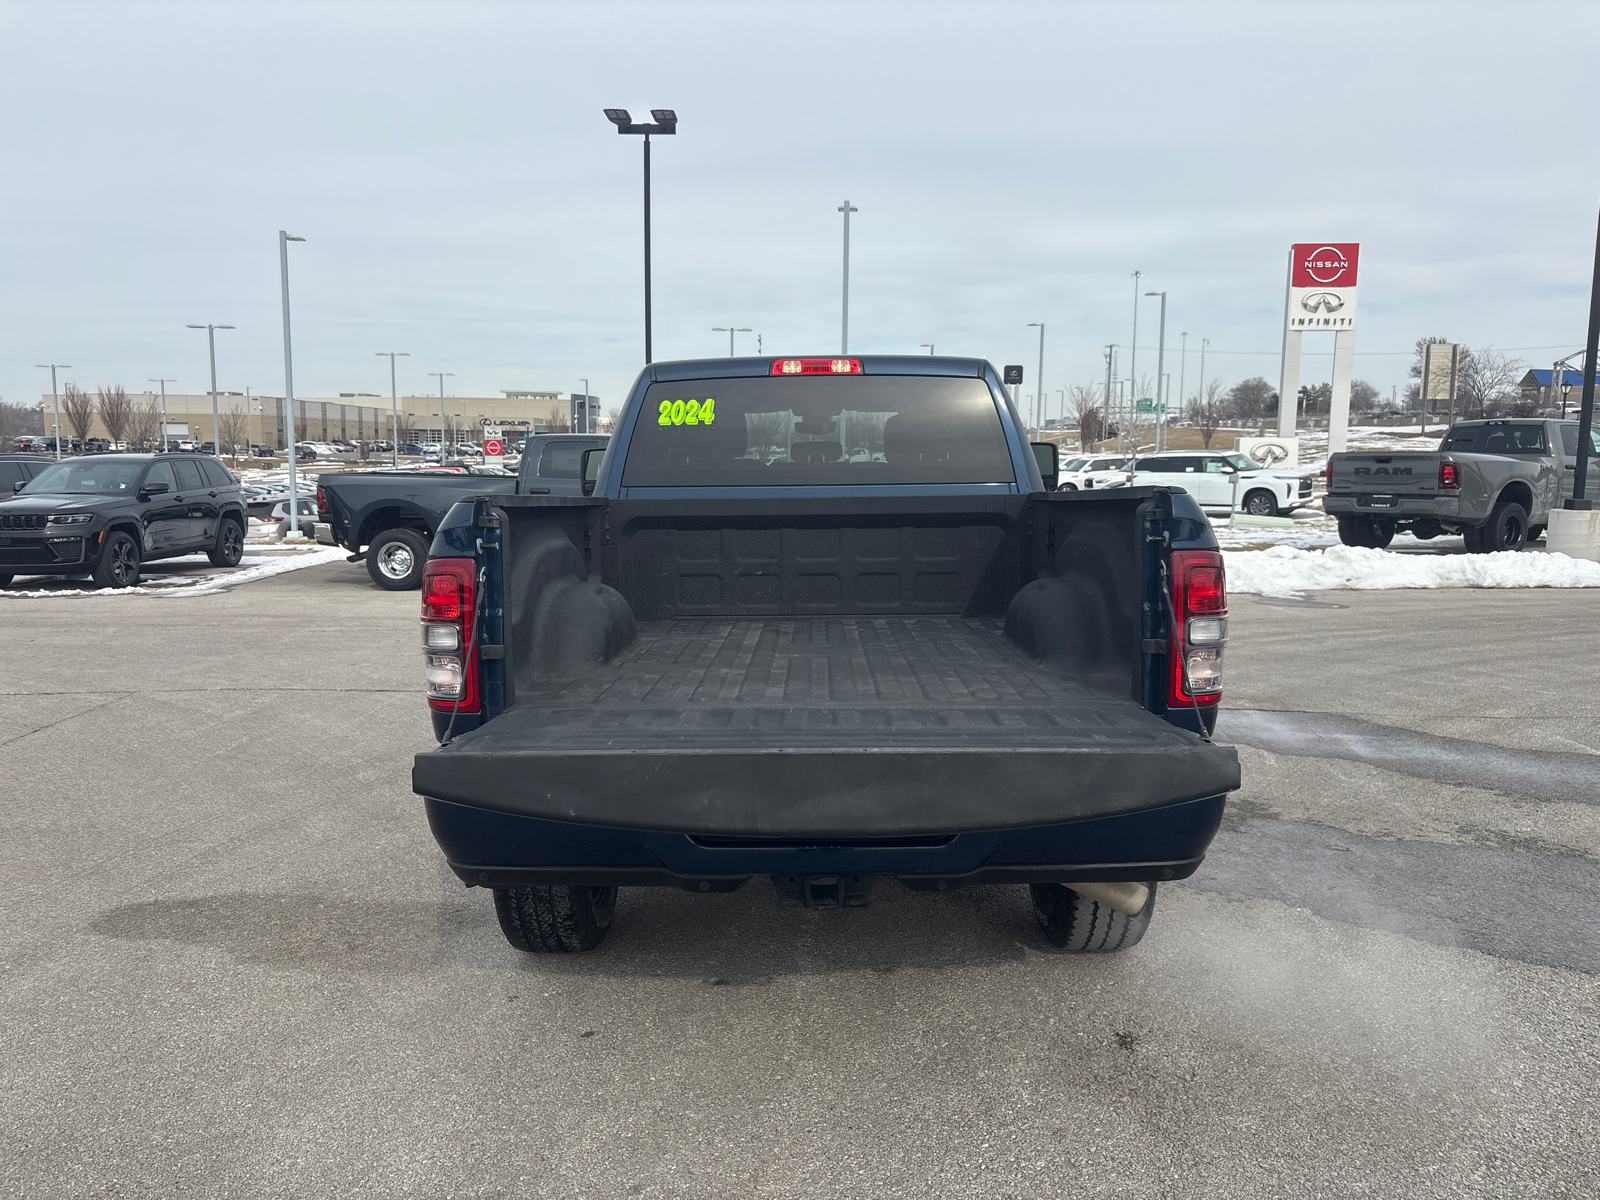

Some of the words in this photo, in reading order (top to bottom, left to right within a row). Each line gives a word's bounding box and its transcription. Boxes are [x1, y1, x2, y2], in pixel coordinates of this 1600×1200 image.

[1291, 317, 1353, 326] INFINITI
[658, 398, 715, 426] 2024
[1353, 467, 1413, 476] RAM
